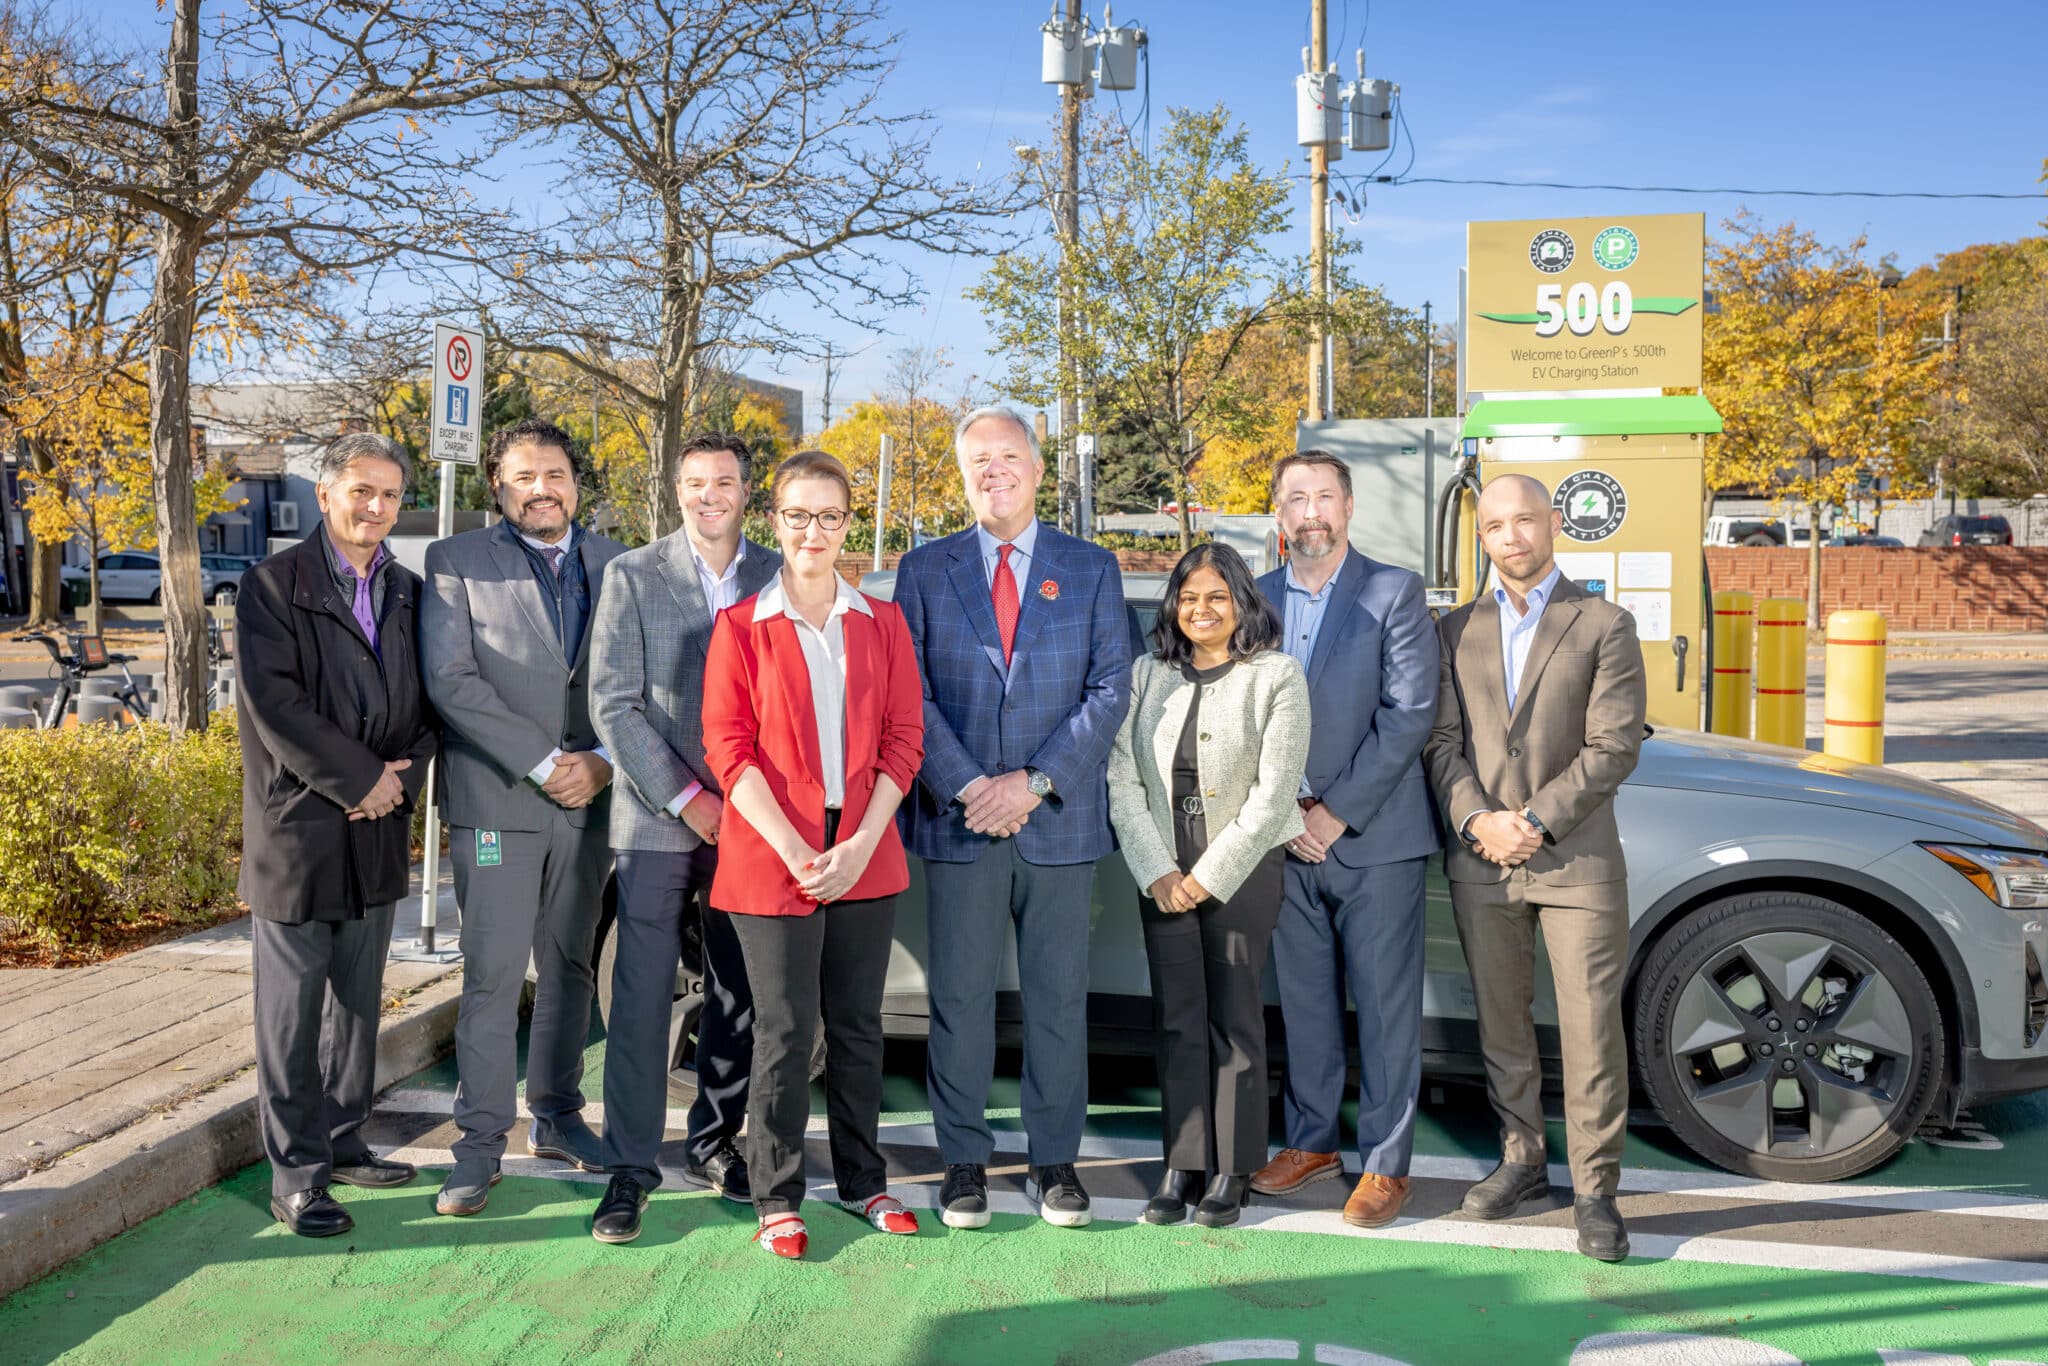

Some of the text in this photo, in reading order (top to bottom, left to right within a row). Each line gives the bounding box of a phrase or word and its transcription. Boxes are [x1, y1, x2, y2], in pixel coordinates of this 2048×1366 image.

[1607, 237, 1626, 256] P
[1535, 281, 1633, 337] 500
[1511, 344, 1666, 362] Welcome to GreenP's 500th
[1532, 364, 1639, 381] EV Charging Station
[439, 427, 474, 442] EXCEPT WHILE
[444, 440, 468, 453] CHARGING
[1555, 472, 1624, 501] EV CHARGE
[1559, 511, 1623, 540] TATIONS
